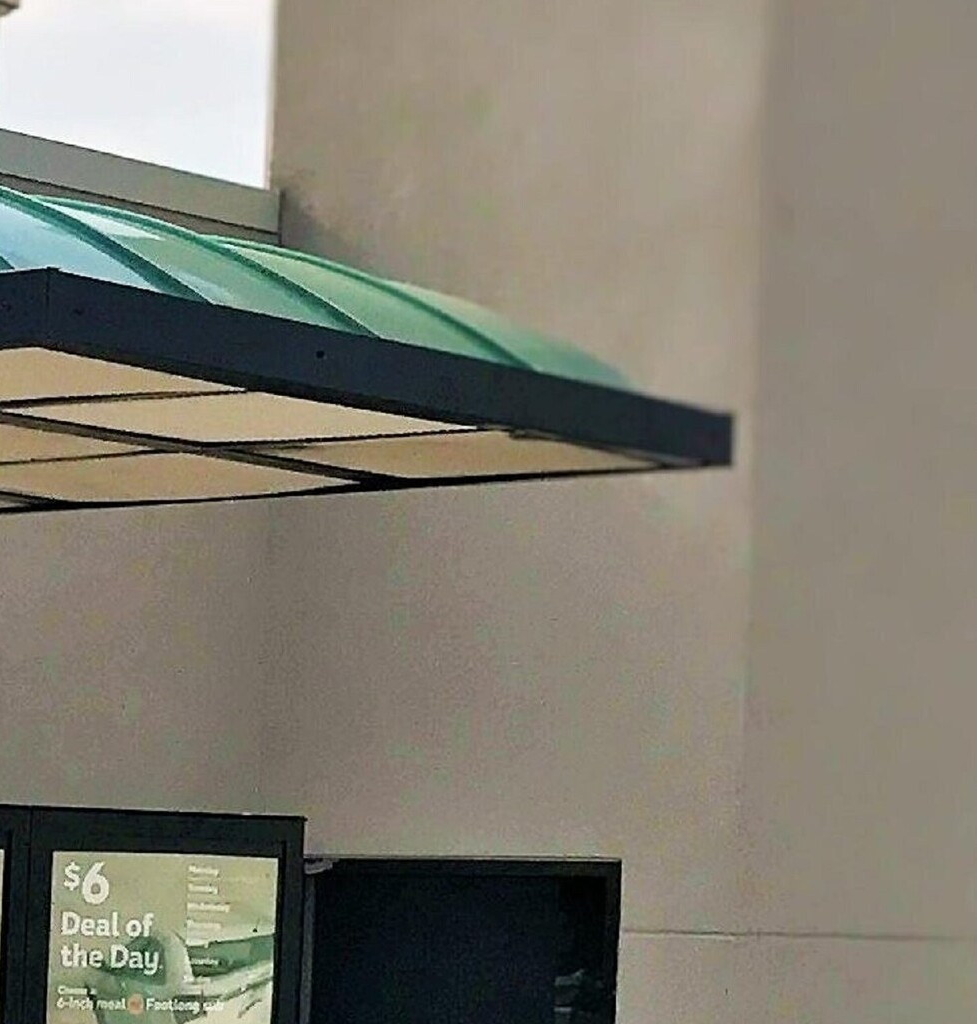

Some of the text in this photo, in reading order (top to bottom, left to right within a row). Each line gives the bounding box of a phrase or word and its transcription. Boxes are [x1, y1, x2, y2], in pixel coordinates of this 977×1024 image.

[63, 861, 111, 905] $6
[61, 911, 155, 936] Deal of
[60, 945, 103, 968] the
[97, 998, 126, 1010] meal
[146, 999, 200, 1015] Footlong
